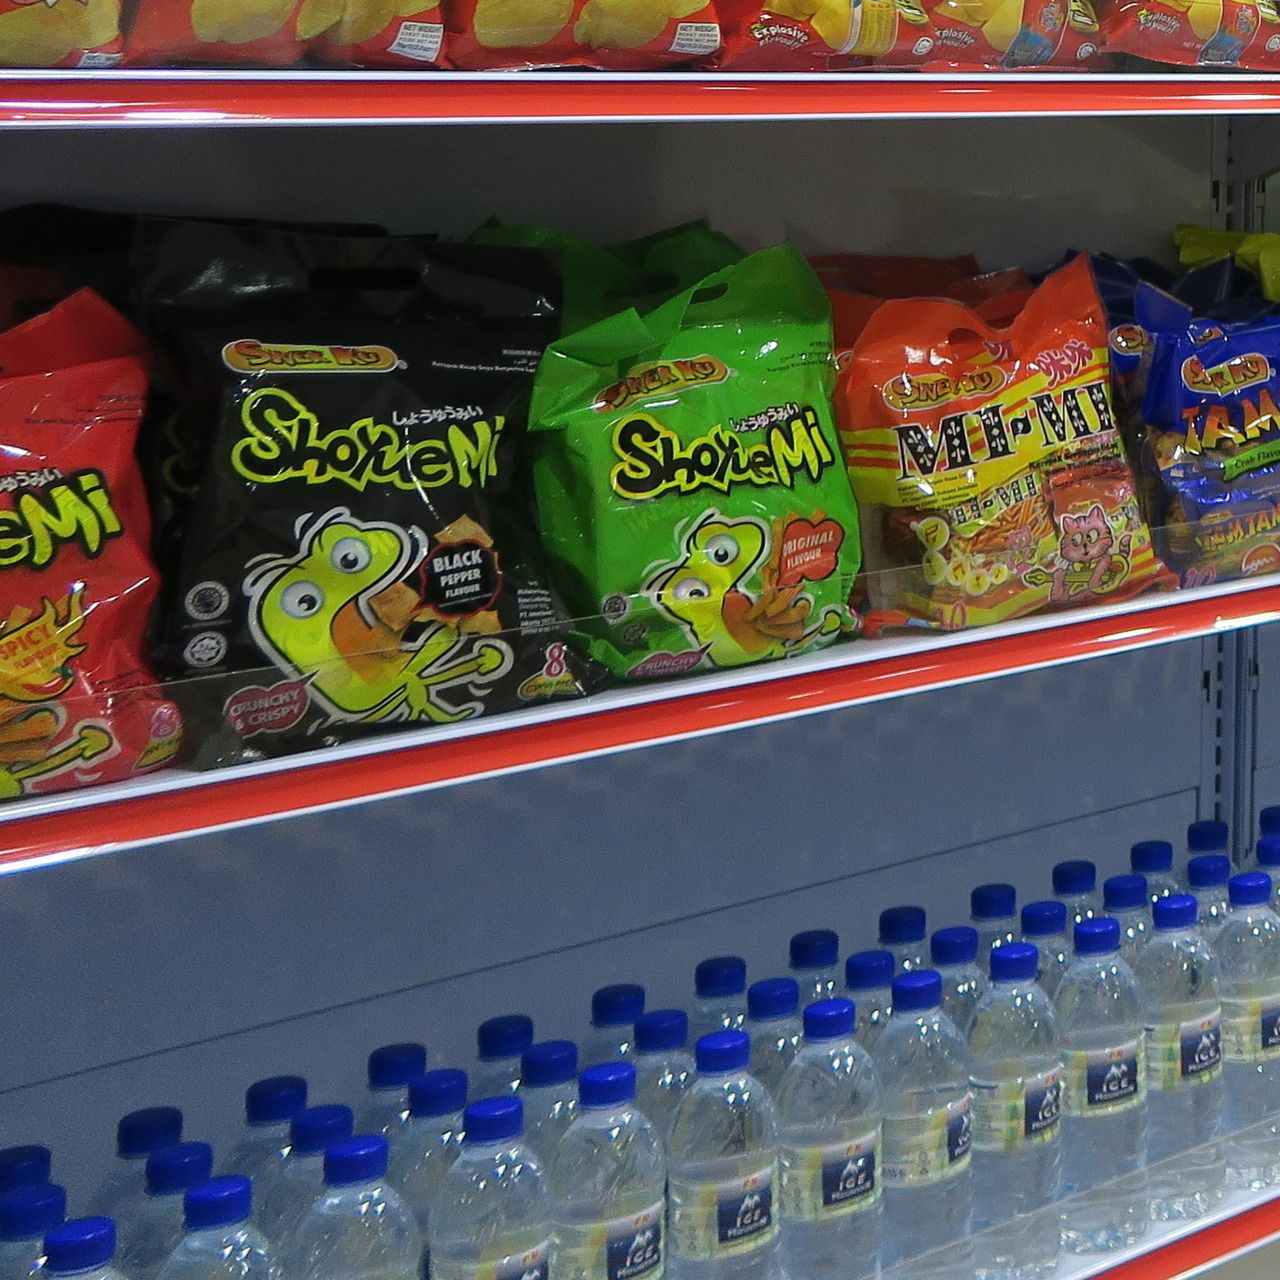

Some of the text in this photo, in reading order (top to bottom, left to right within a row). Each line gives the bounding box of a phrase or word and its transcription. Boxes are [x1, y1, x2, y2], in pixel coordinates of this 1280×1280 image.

[754, 25, 809, 42] Explosive
[432, 550, 483, 574] BLACK
[440, 570, 482, 586] PEPPER
[445, 583, 480, 599] FLAVOUR
[230, 690, 301, 718] CRUNCHY
[248, 700, 301, 726] CRISPY
[1195, 1049, 1216, 1063] ICE
[1103, 1079, 1129, 1093] ICE
[839, 1176, 866, 1192] ICE
[737, 1212, 761, 1227] ICE
[626, 1247, 653, 1266] ICE
